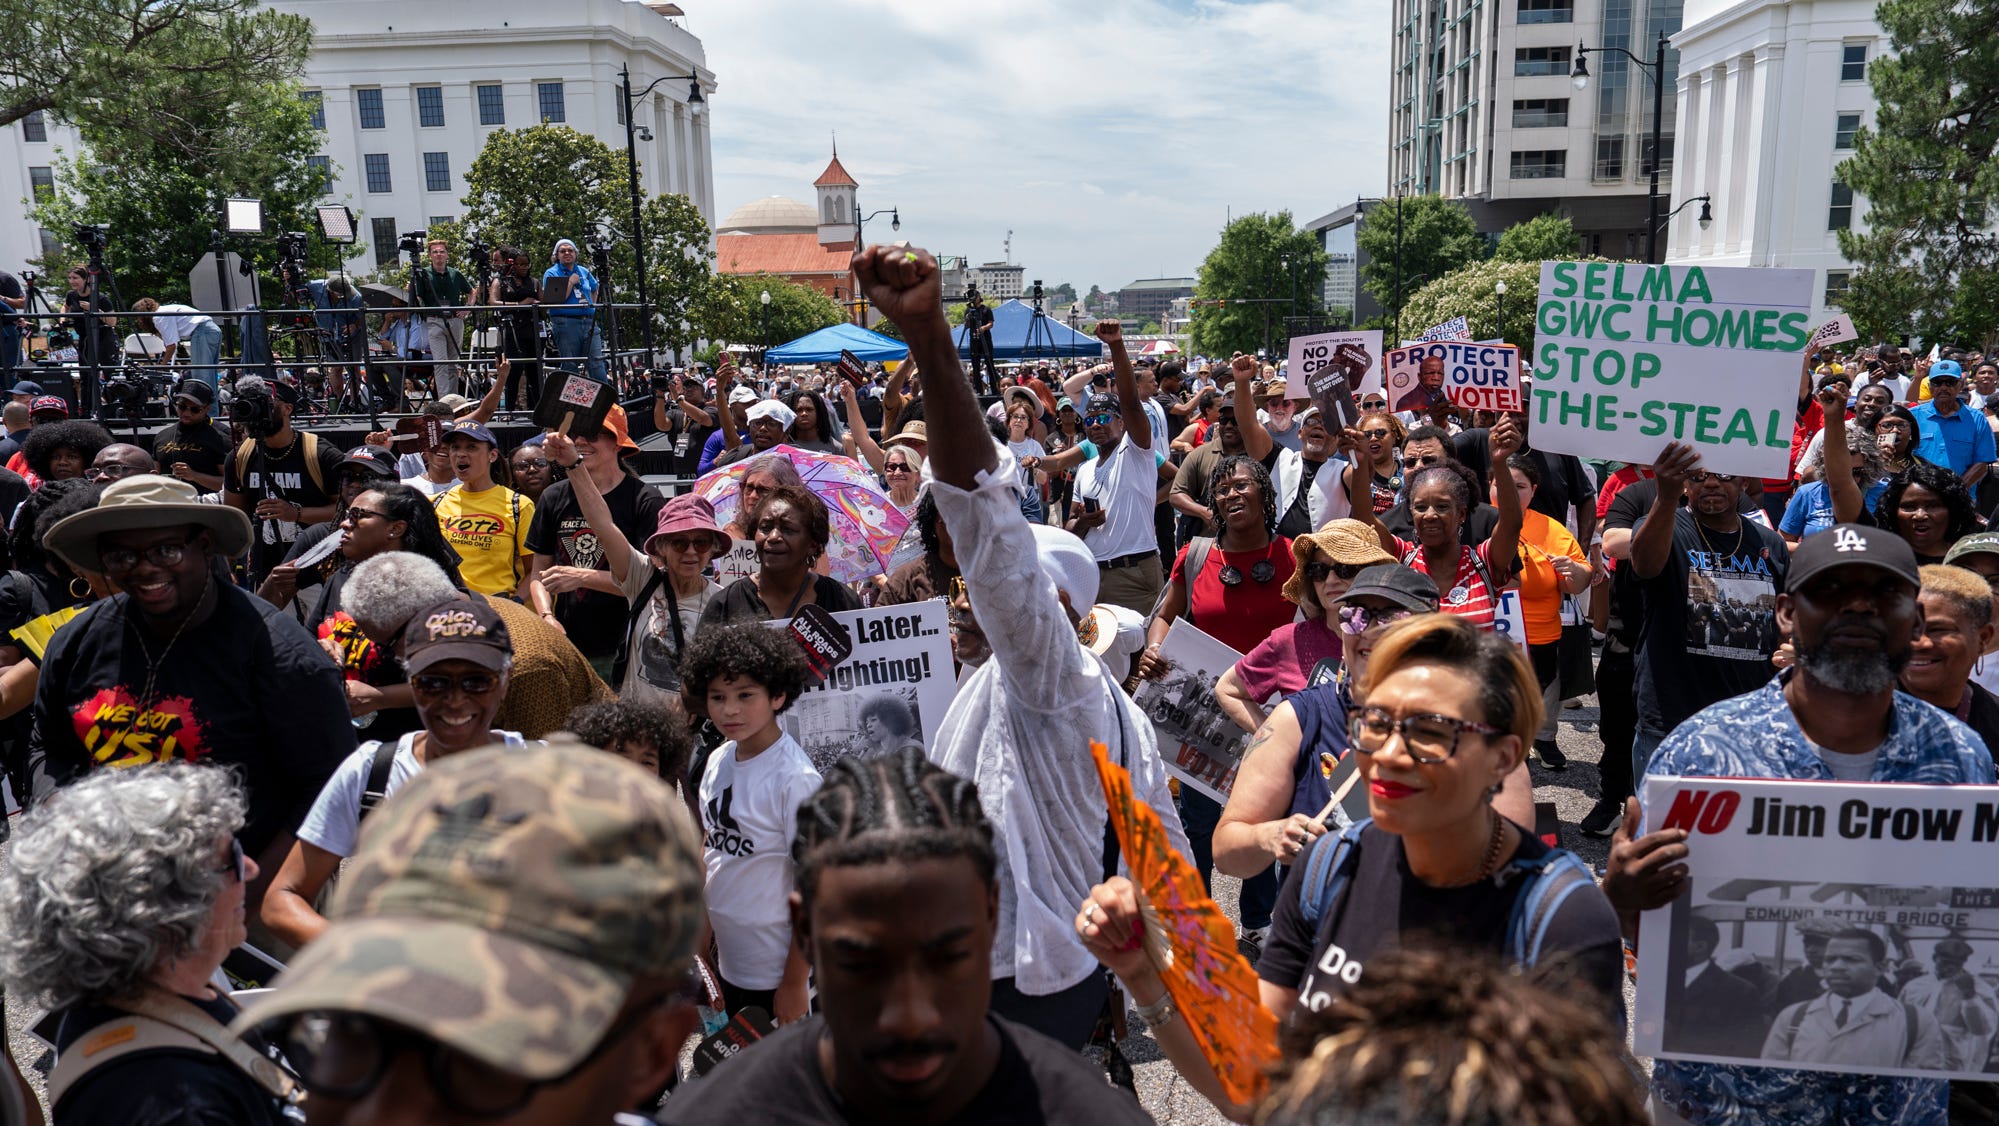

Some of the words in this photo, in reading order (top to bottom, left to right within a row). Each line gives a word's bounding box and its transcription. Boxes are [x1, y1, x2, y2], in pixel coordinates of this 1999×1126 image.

[1552, 261, 1713, 304] SELMA
[1451, 324, 1464, 333] UR
[1538, 300, 1632, 341] GWC
[1647, 304, 1809, 352] HOMES
[1303, 346, 1328, 360] NO
[1391, 344, 1514, 369] PROTECT
[1534, 343, 1662, 388] STOP
[1452, 366, 1509, 387] OUR
[1446, 385, 1518, 409] VOTE!
[1533, 389, 1790, 448] THE-STEAL
[250, 472, 302, 489] BAM
[446, 517, 501, 533] VOTE
[561, 520, 580, 528] PEACE
[452, 532, 469, 540] OUR
[471, 533, 493, 543] LIVES
[1833, 527, 1867, 552] LA
[1687, 549, 1772, 576] SELMA
[792, 620, 814, 643] LEAD
[813, 641, 825, 654] TO
[796, 617, 813, 633] ALL
[811, 631, 839, 659] ROADS
[856, 614, 939, 644] Later...
[819, 651, 931, 694] ighting!
[94, 703, 136, 722] WE
[136, 709, 180, 731] GOT
[1661, 789, 1741, 835] NO
[1746, 797, 1827, 838] Jim
[1838, 799, 1963, 842] Crow
[1956, 894, 1992, 906] THIS
[1745, 907, 1814, 920] EDMUND
[1897, 911, 1970, 926] BRIDGE
